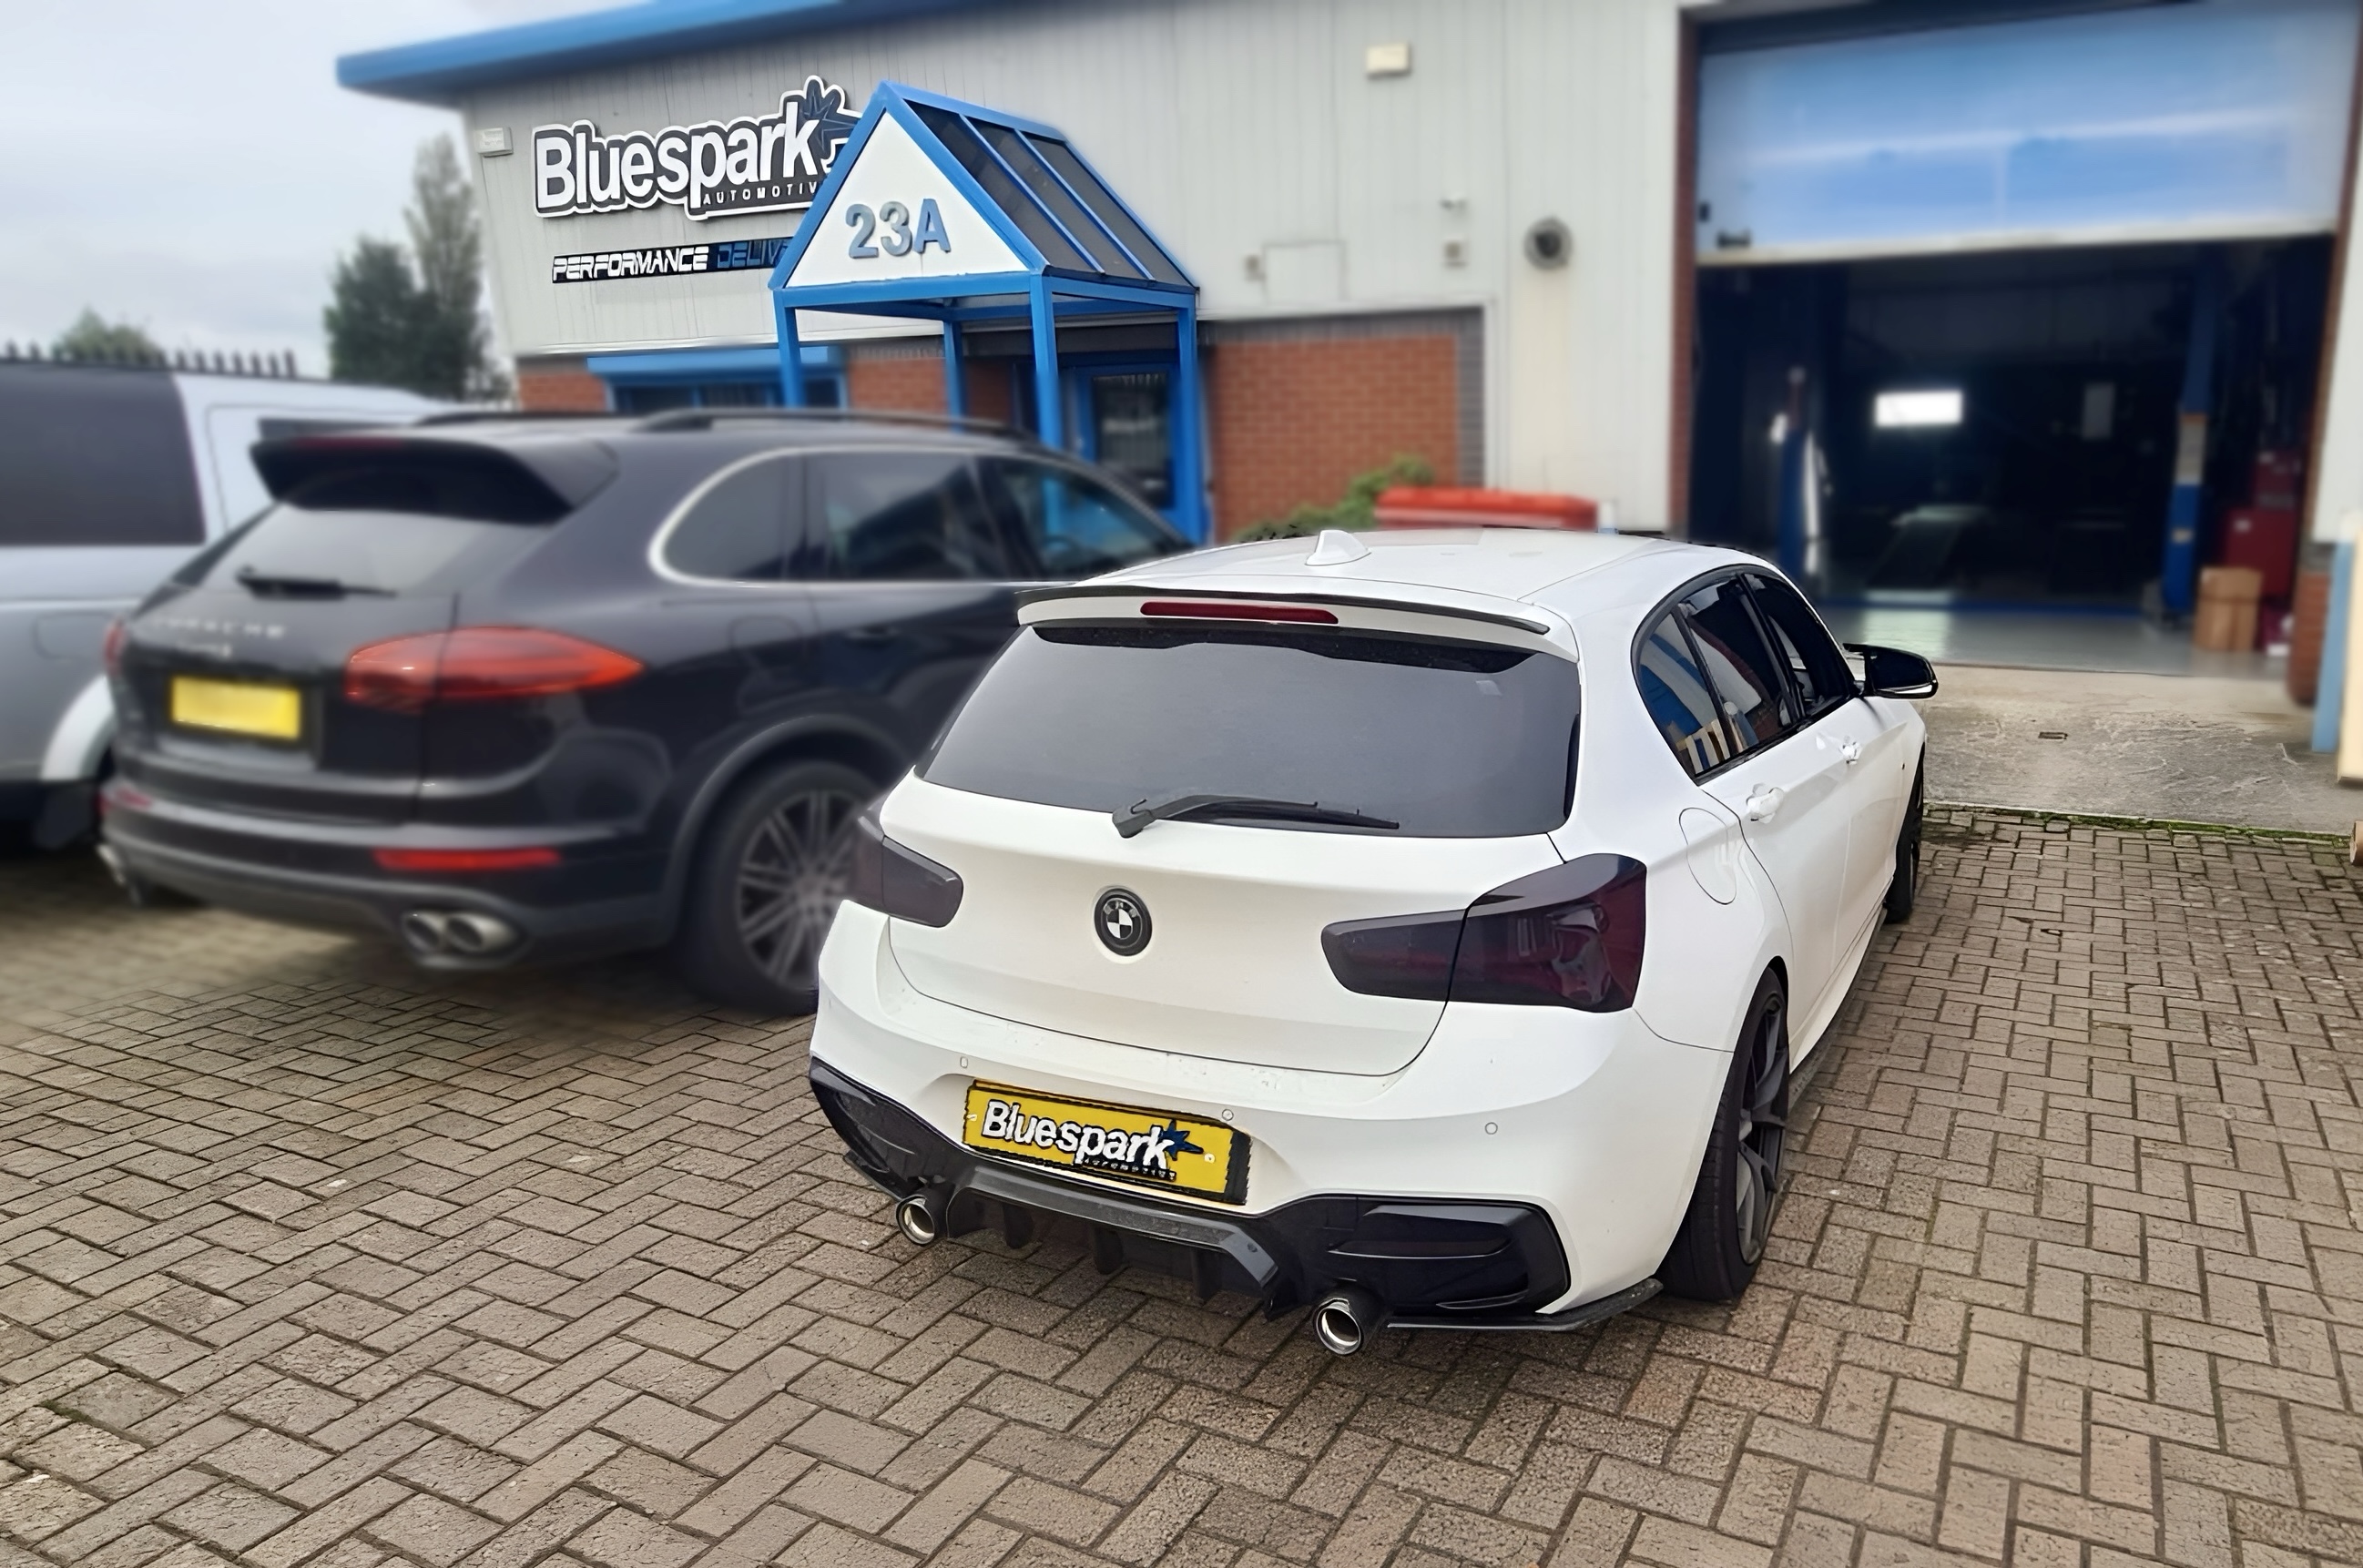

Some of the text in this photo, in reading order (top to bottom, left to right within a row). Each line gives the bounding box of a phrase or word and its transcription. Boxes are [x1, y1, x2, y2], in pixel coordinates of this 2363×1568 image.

[535, 101, 819, 209] Bluespark
[702, 181, 818, 206] AUTOMOTIV
[845, 198, 952, 260] 23A
[553, 246, 709, 281] PERFORMANCE
[982, 1099, 1175, 1169] Bluespark
